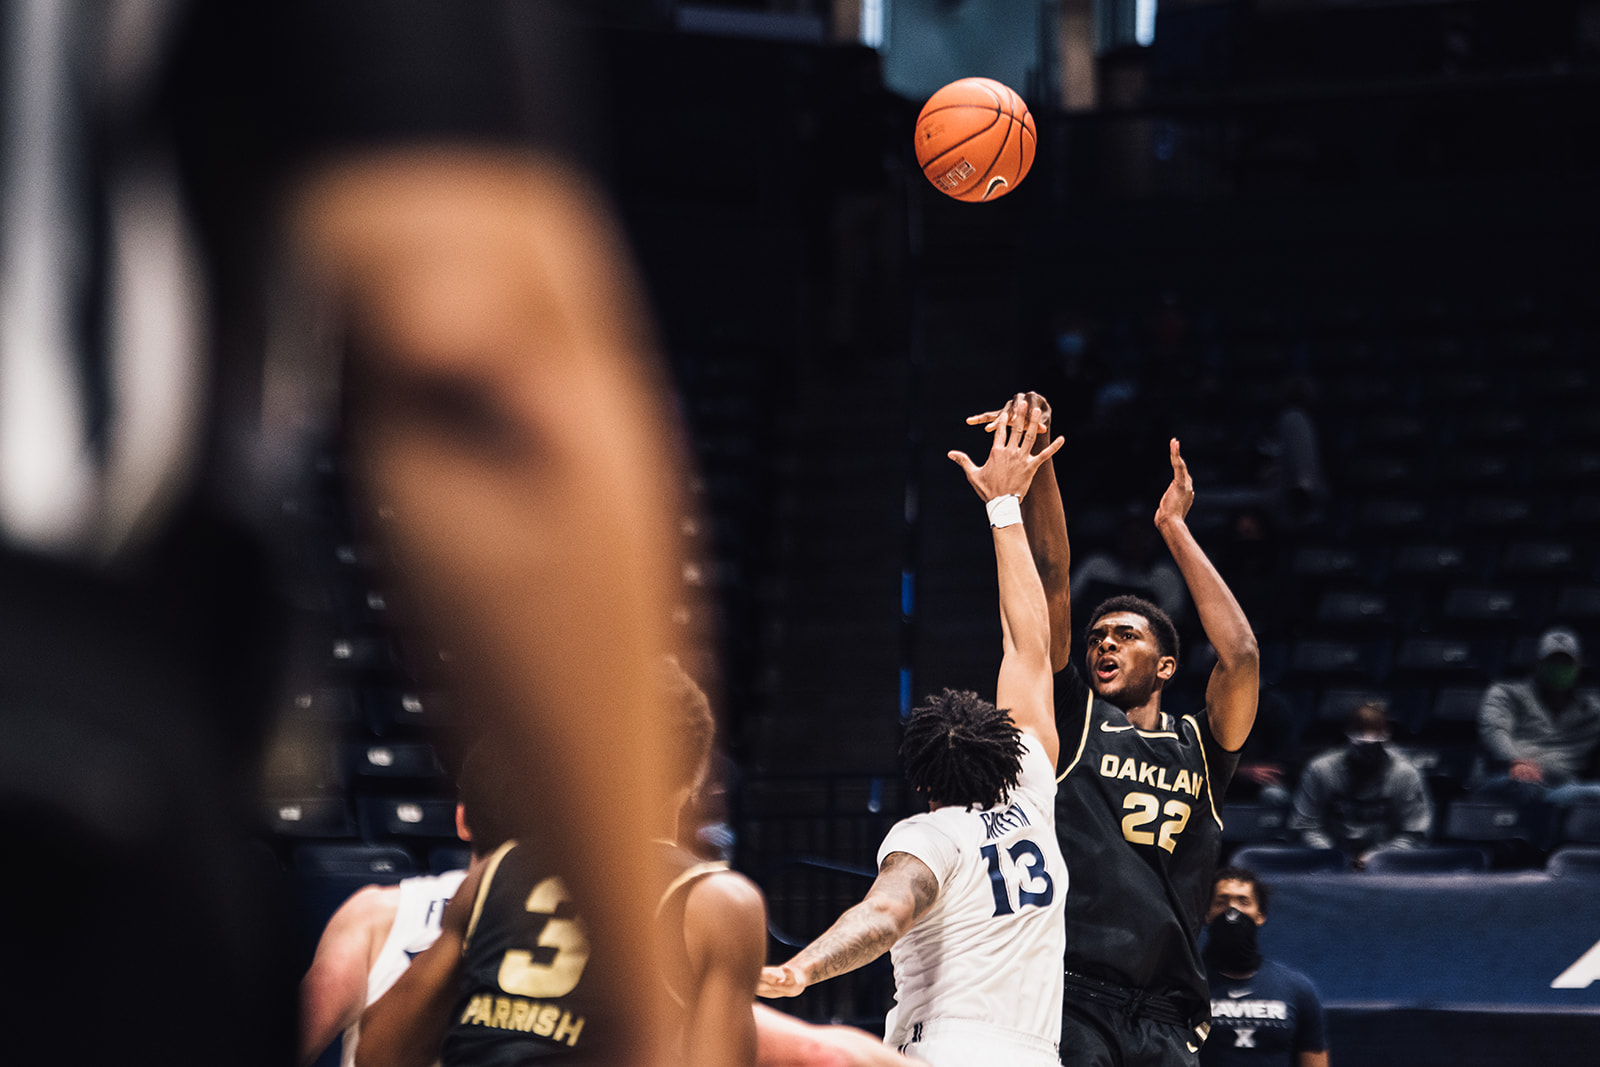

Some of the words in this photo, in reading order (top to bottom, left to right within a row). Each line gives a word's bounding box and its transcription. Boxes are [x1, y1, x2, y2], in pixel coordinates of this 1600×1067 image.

[1121, 791, 1191, 855] 22
[980, 839, 1054, 918] 13
[498, 875, 590, 998] 3
